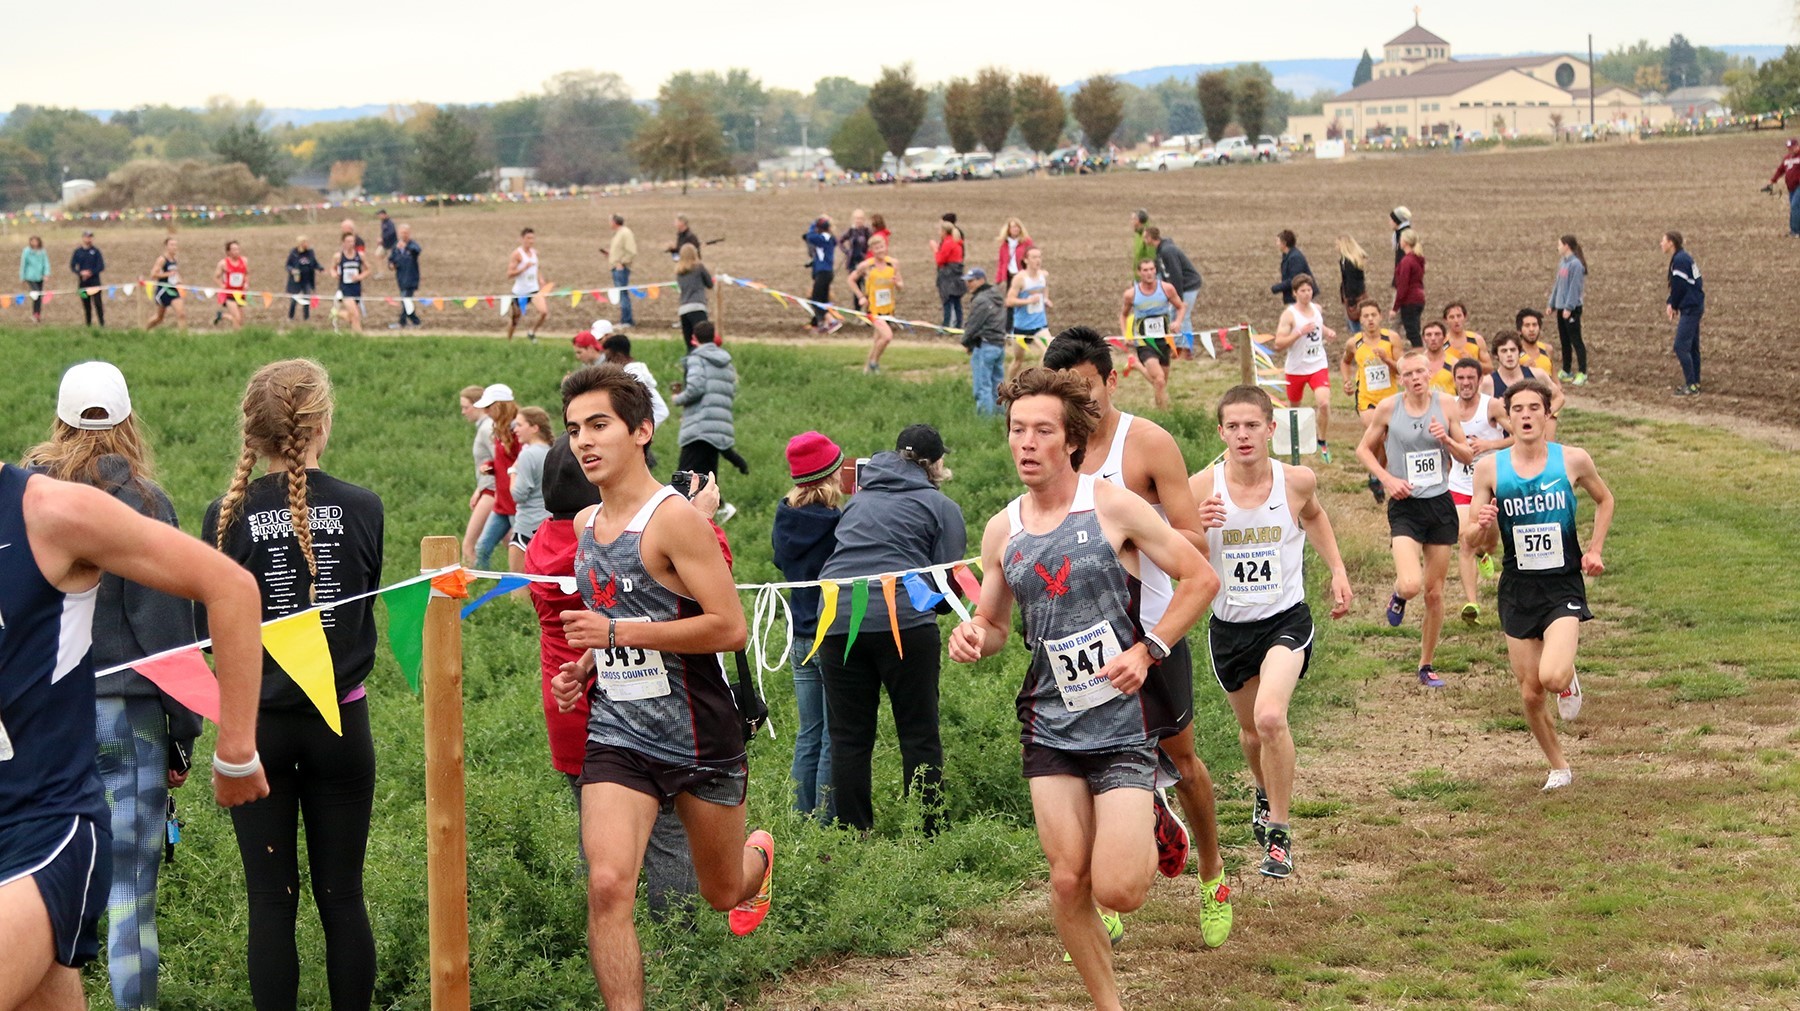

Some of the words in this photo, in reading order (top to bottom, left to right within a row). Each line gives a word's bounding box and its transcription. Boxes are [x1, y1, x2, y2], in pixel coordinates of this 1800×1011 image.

[1415, 458, 1435, 473] 568
[1503, 490, 1565, 517] OREGON
[256, 509, 293, 526] BIG
[260, 519, 344, 536] INVITONAL
[1222, 526, 1282, 546] IDAHO
[1076, 530, 1089, 545] D
[1524, 533, 1552, 552] 576
[1251, 549, 1276, 558] EMPIRE
[1234, 560, 1271, 583] 424
[622, 578, 633, 593] D
[1250, 583, 1279, 592] COUNTRY
[1048, 640, 1075, 652] INLAND
[1076, 626, 1107, 646] EMPIRE
[1058, 640, 1106, 682] 347
[601, 671, 621, 680] CROSS
[622, 667, 659, 680] COUNTRY
[1064, 683, 1088, 694] CROSS
[1088, 674, 1110, 688] COUN
